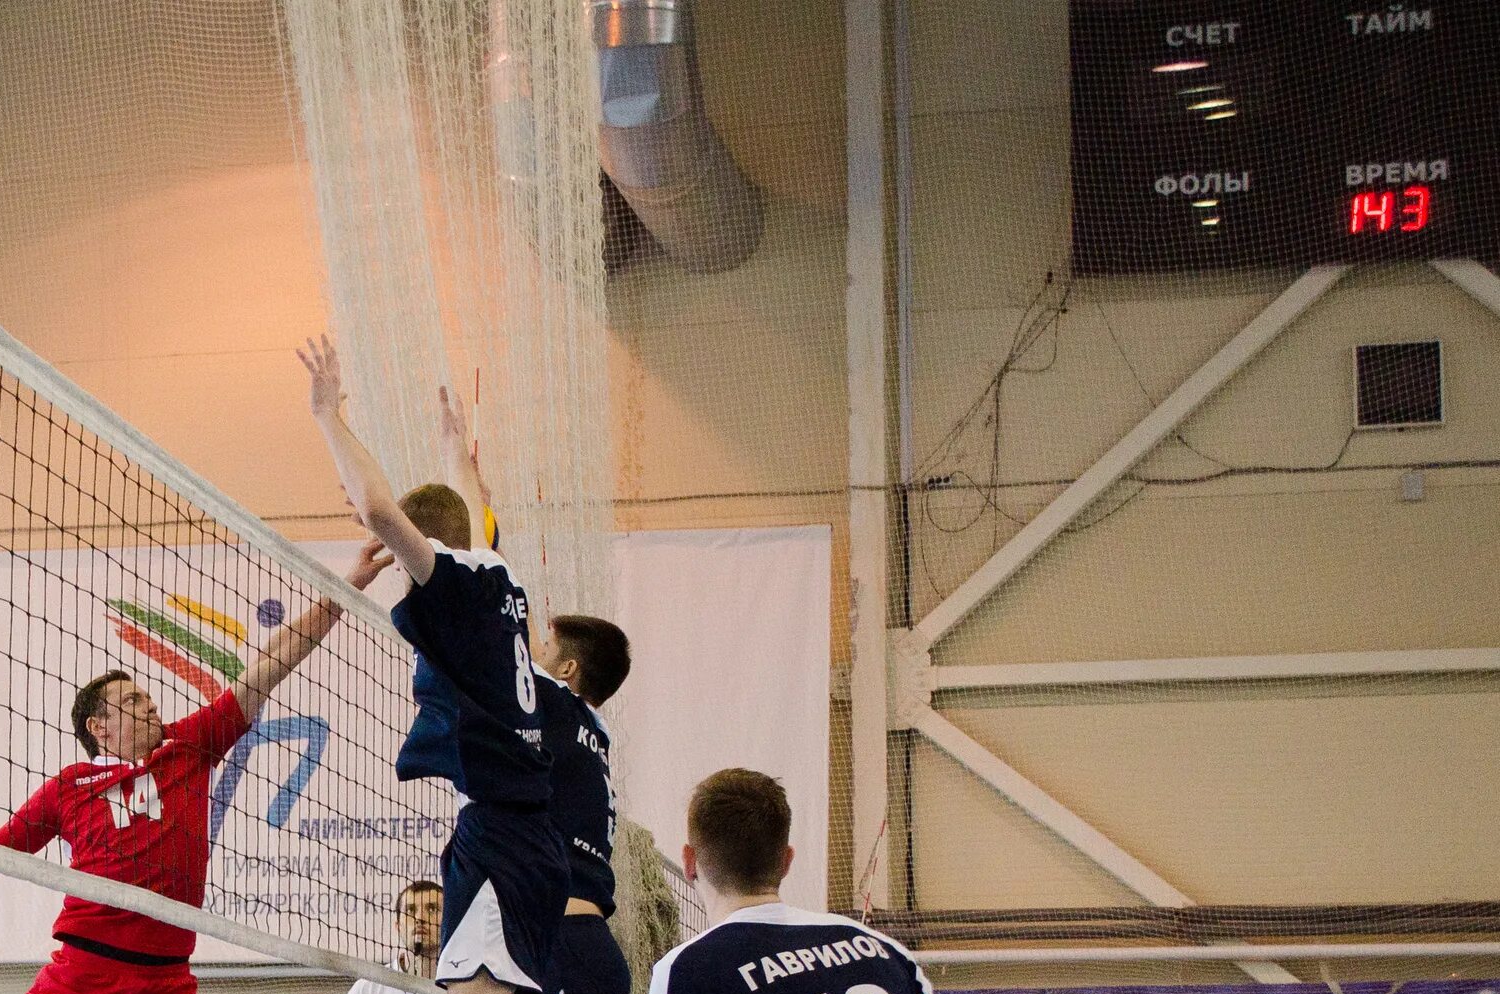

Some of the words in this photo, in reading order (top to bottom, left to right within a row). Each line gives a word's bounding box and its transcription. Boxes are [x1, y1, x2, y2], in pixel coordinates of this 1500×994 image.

[1346, 5, 1434, 35] ТАЙМ
[1165, 22, 1240, 47] СЧЕТ
[1154, 171, 1250, 195] ФОЛЫ
[1346, 159, 1448, 185] ВРЕМЯ
[514, 633, 537, 714] 8
[98, 772, 164, 829] 14
[223, 854, 324, 878] ТУРИЗМА
[333, 855, 346, 877] И
